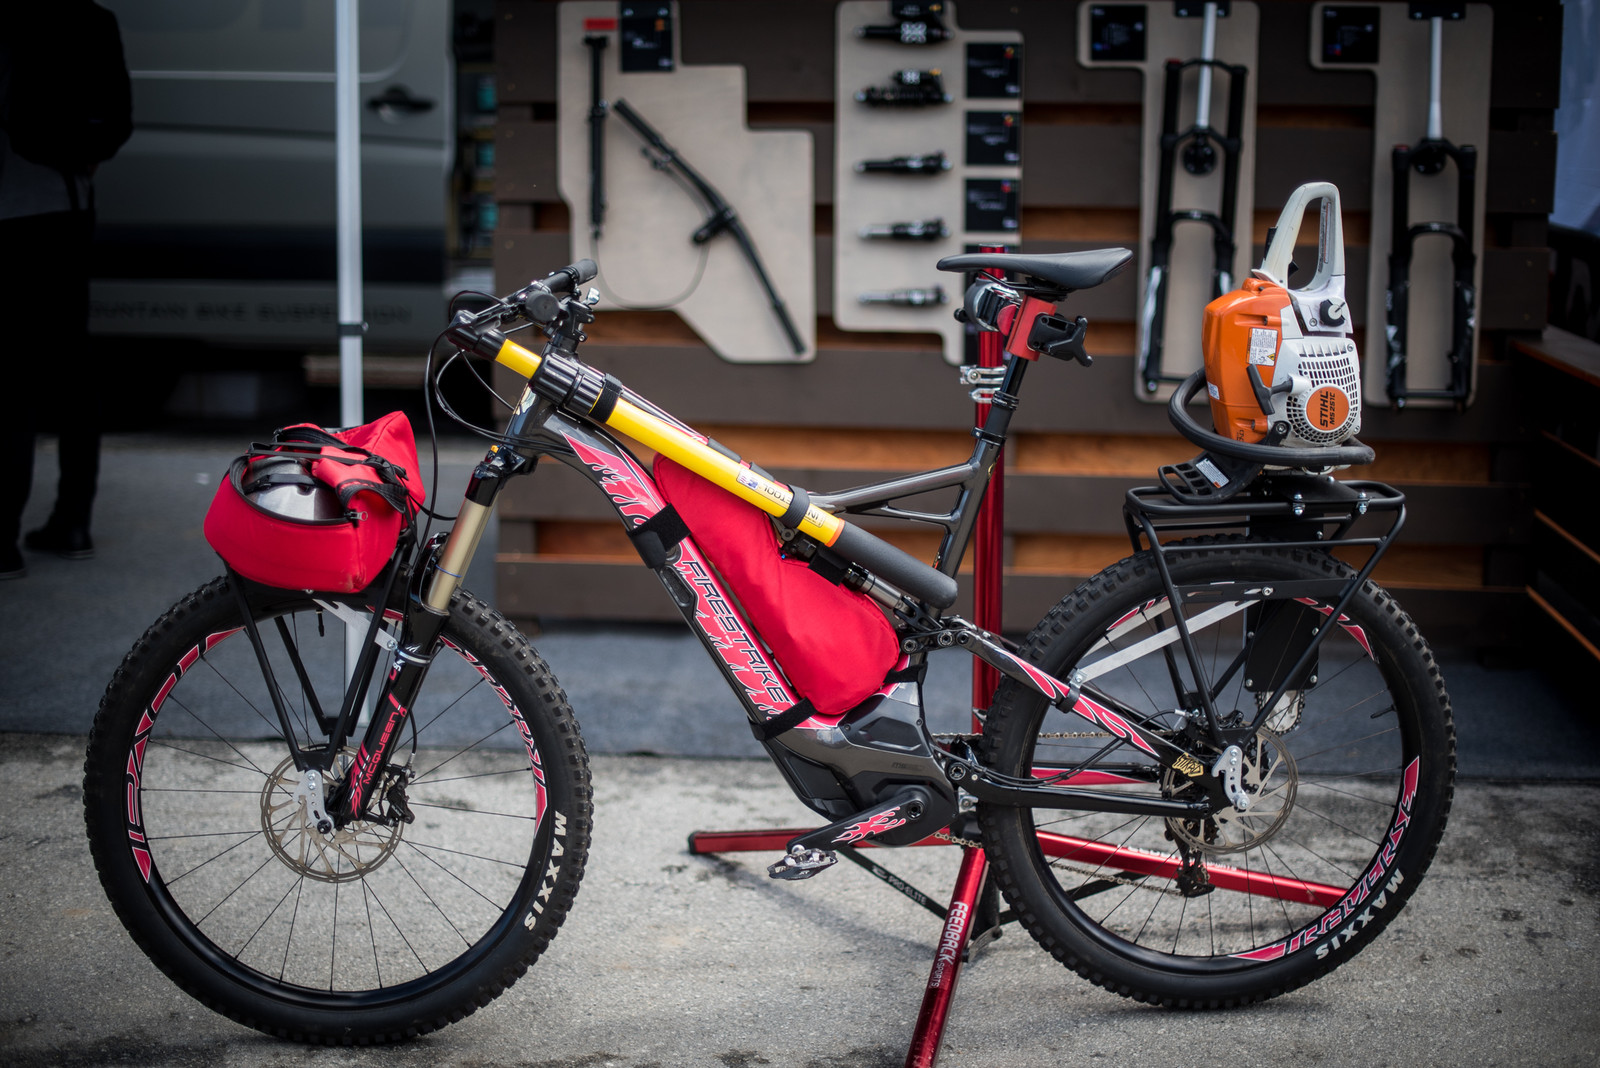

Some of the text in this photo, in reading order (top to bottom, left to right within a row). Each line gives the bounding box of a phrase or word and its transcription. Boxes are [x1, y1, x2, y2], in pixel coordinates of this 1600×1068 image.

[88, 300, 187, 321] OUNTAIN
[1319, 391, 1329, 428] STIHL
[682, 561, 791, 703] FIRESTRIKE
[363, 711, 399, 784] MCQUEEN
[524, 811, 567, 931] MAXXIS
[937, 901, 969, 965] FEEDBACK
[1315, 868, 1405, 960] MAXXIS
